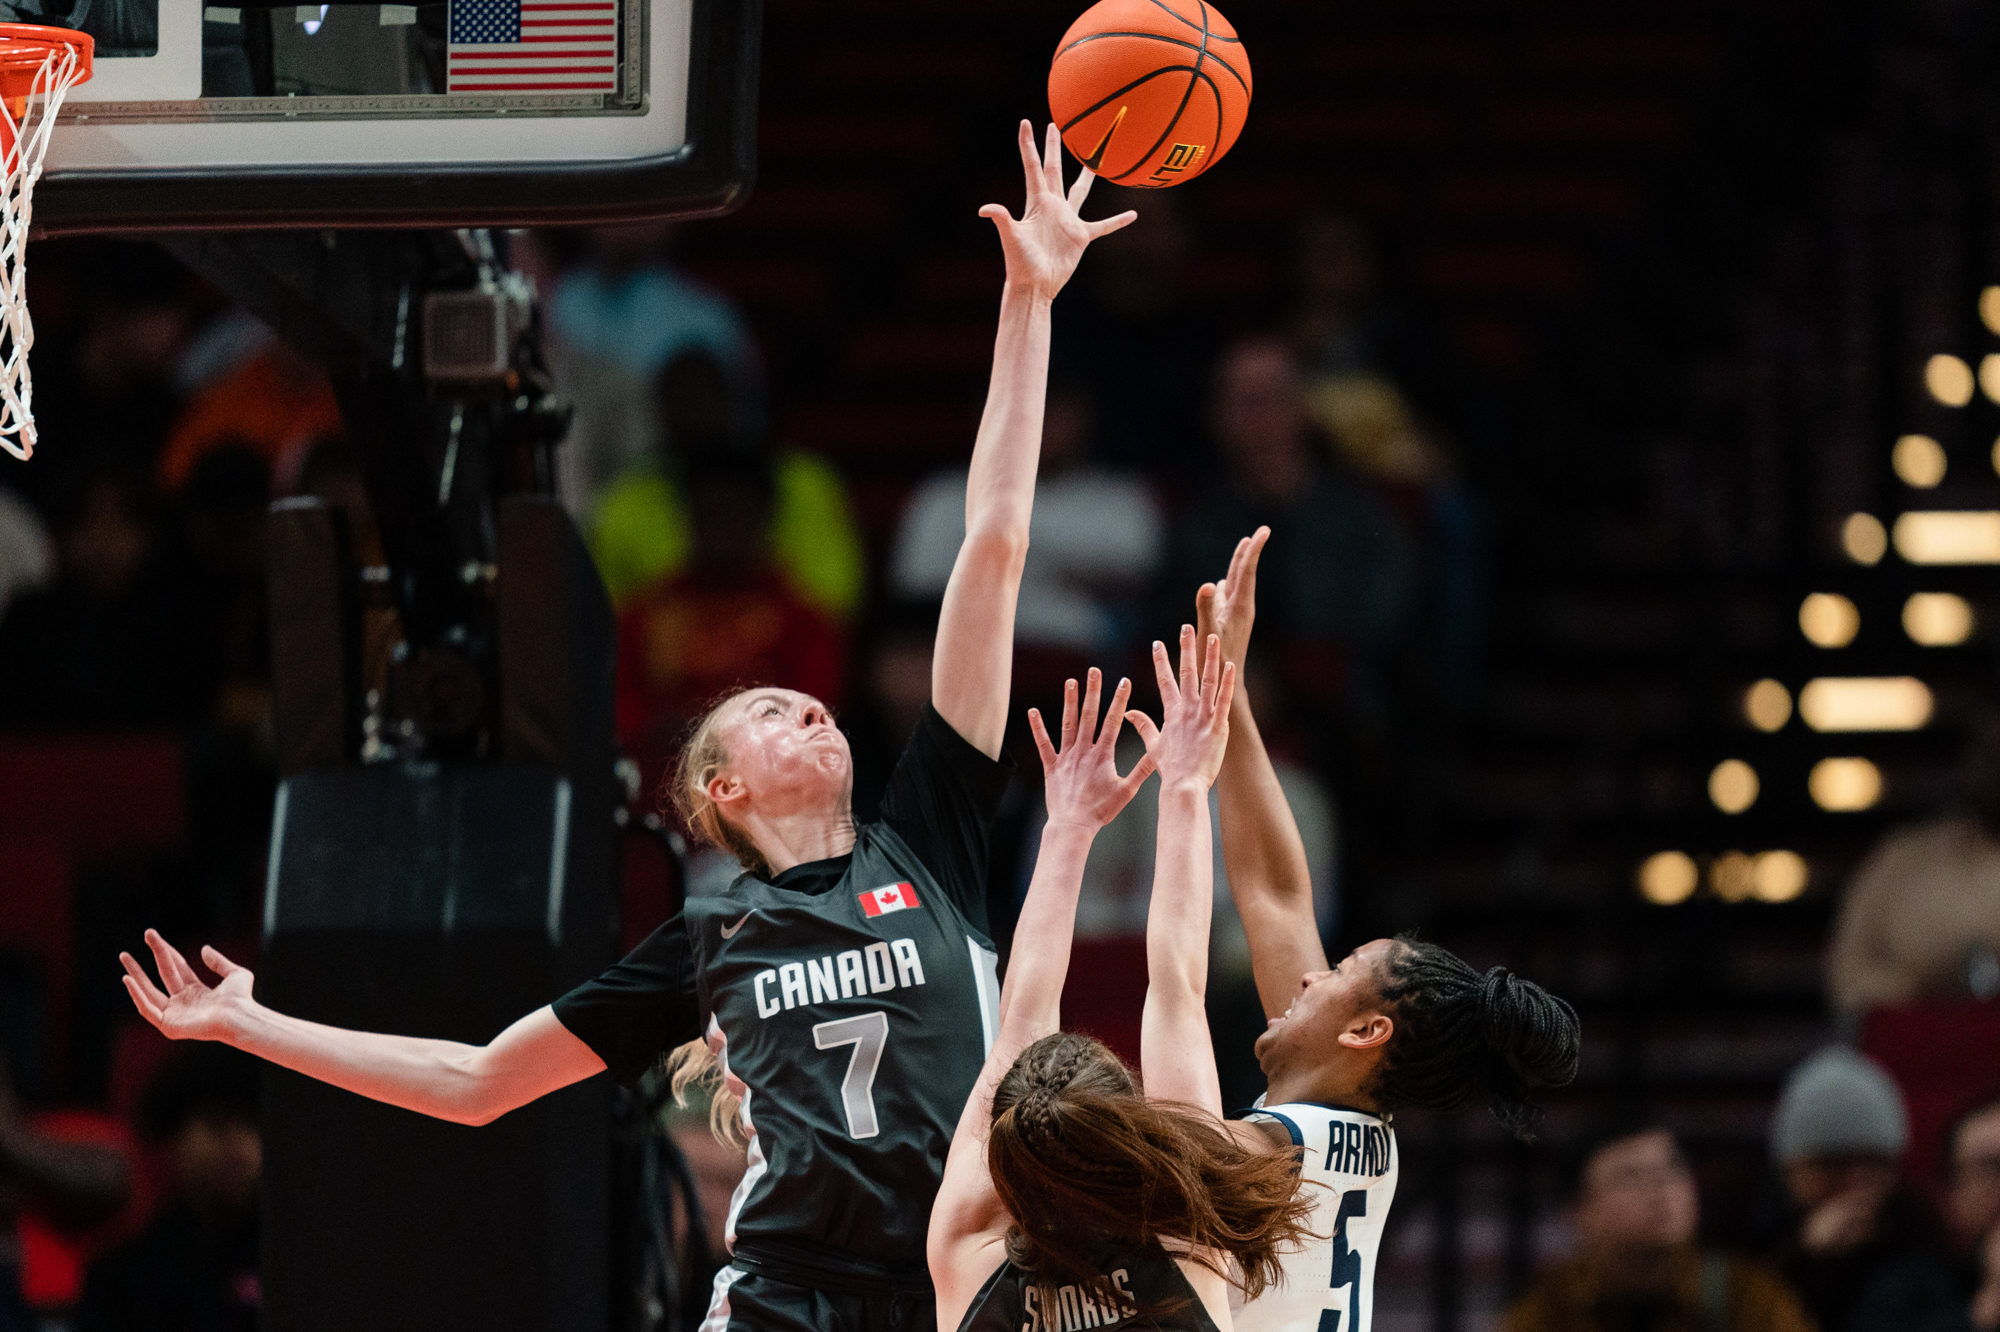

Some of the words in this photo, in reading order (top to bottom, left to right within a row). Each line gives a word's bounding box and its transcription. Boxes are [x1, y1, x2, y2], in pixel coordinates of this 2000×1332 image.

[754, 938, 925, 1019] CANADA
[812, 1011, 889, 1139] 7
[1317, 1189, 1367, 1332] 5
